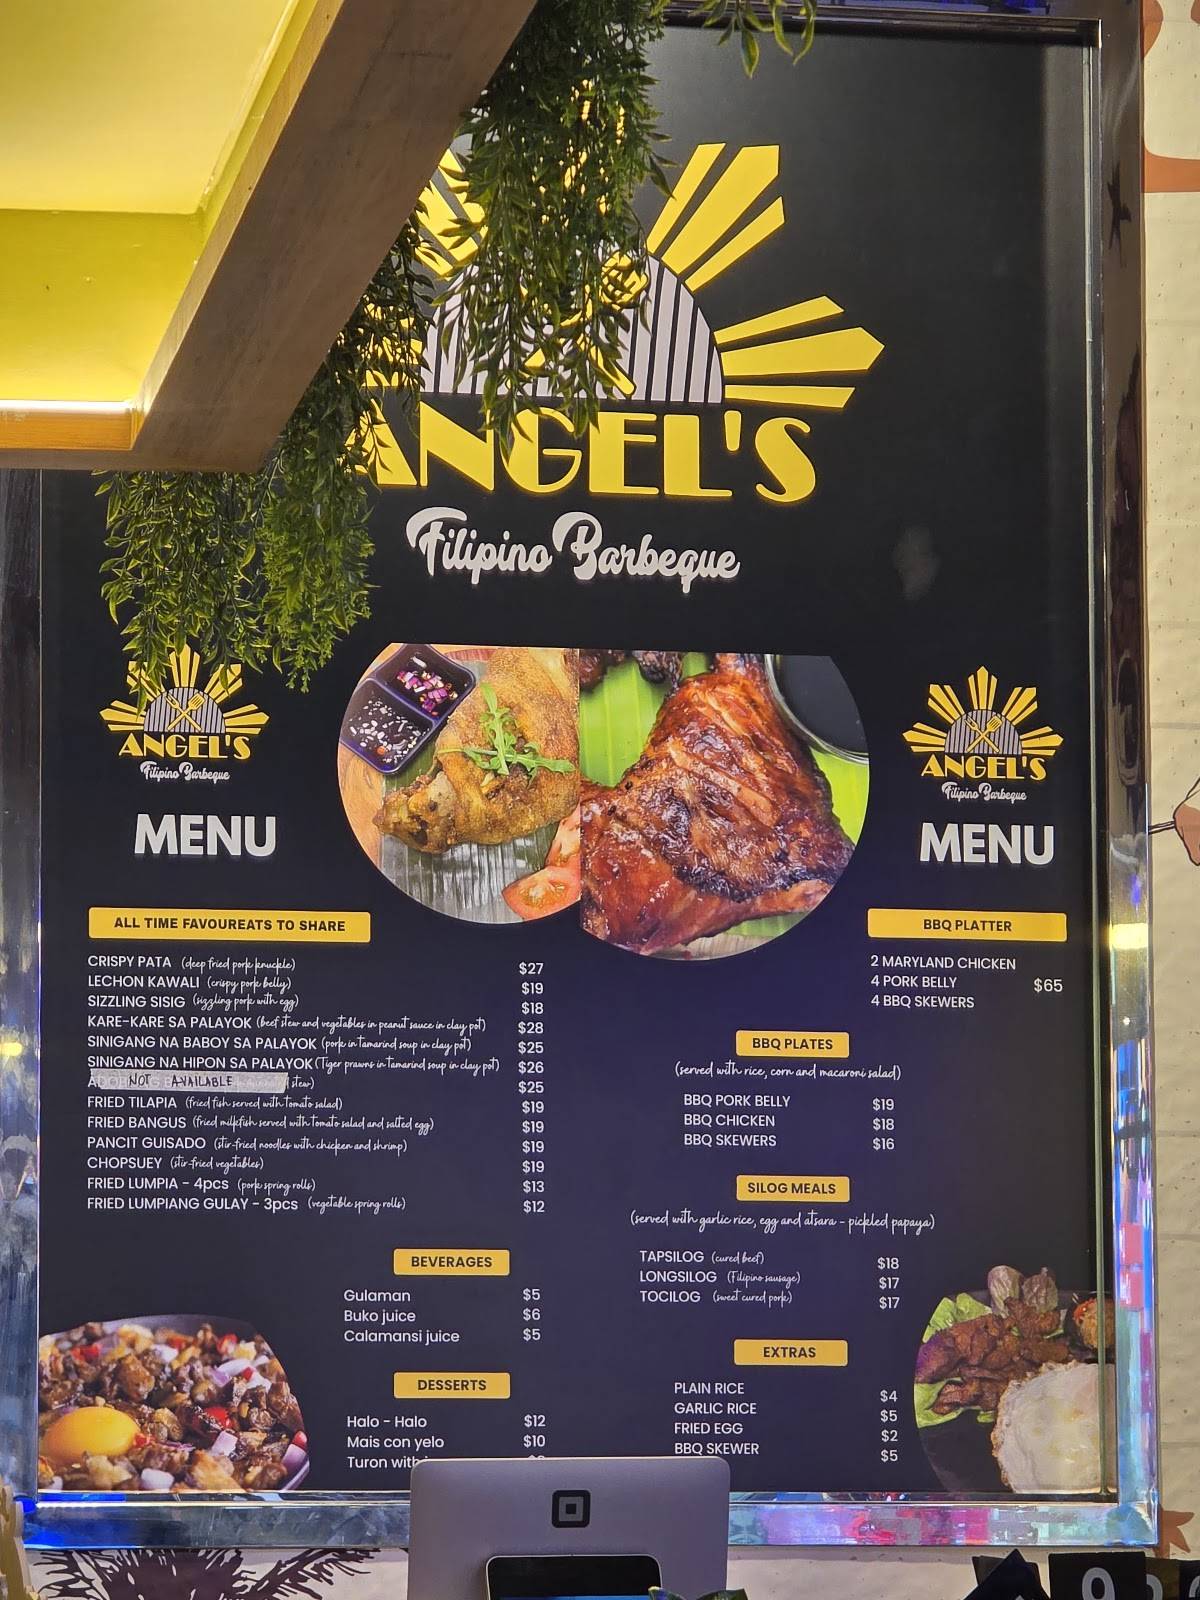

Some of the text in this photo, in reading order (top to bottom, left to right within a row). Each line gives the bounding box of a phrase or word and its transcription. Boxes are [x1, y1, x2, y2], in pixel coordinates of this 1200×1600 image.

[406, 507, 740, 593] Filipino Barbeque
[119, 733, 250, 759] ANGEL'S
[140, 761, 230, 784] Filipino Barbeque
[921, 755, 1047, 781] ANGEL'S
[942, 782, 1027, 804] Filipino Barbeque
[135, 814, 275, 856] MENU
[920, 823, 1053, 865] MENU
[114, 917, 345, 931] ALL TIME FAVOUREATS TO SHARE
[924, 919, 1011, 931] BBQ PLATTER
[88, 956, 296, 975] CRISPY PATA (deep fried pork knuckle)
[519, 962, 543, 975] $27
[871, 955, 1015, 969] 2 MARYLAND CHICKEN
[89, 975, 292, 994] LECHON KAWALI (crispy pork belly)
[871, 975, 956, 988] 4 PORK BELLY
[1034, 978, 1062, 992] $65
[522, 982, 543, 995] $19
[88, 995, 185, 1007] SIZZLING SISIG
[871, 995, 974, 1008] 4 BBQ SKEWERS
[522, 1002, 543, 1014] $18
[88, 1016, 251, 1028] KARE-KARE SA PALAYOK
[519, 1022, 543, 1034] $28
[88, 1036, 316, 1049] SINIGANG NA BABOY SA PALAYOK
[519, 1041, 543, 1054] $25
[753, 1038, 832, 1050] BBQ PLATES
[88, 1056, 312, 1069] SINIGANG NA HIPON SA PALAYOK
[519, 1061, 543, 1074] $26
[675, 1060, 901, 1080] (served with rice, corn and macaroni salad)
[128, 1074, 151, 1086] NOT
[171, 1075, 233, 1087] AVAILABLE
[519, 1081, 544, 1094] $25
[88, 1096, 177, 1108] FRIED TILAPIA
[522, 1101, 544, 1113] $19
[684, 1094, 790, 1107] BBQ PORK BELLY
[873, 1098, 894, 1111] $19
[88, 1116, 186, 1128] FRIED BANGUS
[523, 1120, 544, 1133] $19
[685, 1114, 775, 1127] BBQ CHICKEN
[873, 1118, 894, 1130] $18
[88, 1137, 206, 1148] PANCIT GUISADO
[523, 1140, 544, 1153] $19
[685, 1134, 776, 1147] BBQ SKEWERS
[873, 1138, 894, 1150] $16
[88, 1156, 264, 1174] CHOPSUEY (stir-fried vegetables)
[523, 1160, 544, 1173] $19
[88, 1178, 124, 1189] FRIED
[129, 1178, 178, 1189] LUMPIA
[194, 1178, 228, 1193] 4pcs
[523, 1180, 544, 1193] $13
[748, 1183, 835, 1194] SILOG MEALS
[88, 1198, 124, 1209] FRIED
[129, 1198, 199, 1209] LUMPIANG
[204, 1198, 248, 1209] GULAY
[264, 1198, 298, 1213] 3pcs
[524, 1200, 544, 1213] $12
[412, 1256, 492, 1267] BEVERAGES
[640, 1251, 765, 1265] TAPSILOG (cured beef)
[878, 1257, 899, 1269] $18
[640, 1271, 717, 1282] LONGSILOG
[879, 1277, 899, 1289] $17
[344, 1290, 410, 1301] Gulaman
[523, 1288, 540, 1301] $5
[640, 1291, 700, 1302] TOCILOG
[879, 1297, 899, 1309] $17
[345, 1310, 415, 1325] Buko juice
[523, 1308, 540, 1321] $6
[344, 1330, 459, 1345] Calamansi juice
[523, 1328, 540, 1341] $5
[764, 1347, 816, 1358] EXTRAS
[418, 1380, 486, 1390] DESSERTS
[675, 1383, 744, 1394] PLAIN RICE
[880, 1390, 897, 1402] $4
[675, 1403, 756, 1414] GARLIC RICE
[348, 1416, 379, 1427] Halo
[395, 1416, 427, 1427] Halo
[525, 1415, 545, 1427] $12
[881, 1410, 897, 1422] $5
[675, 1423, 743, 1434] FRIED EGG
[524, 1435, 545, 1448] $10
[882, 1430, 897, 1442] $2
[348, 1436, 444, 1451] Mais con yelo
[675, 1443, 759, 1455] BBQ SKEWER
[347, 1457, 387, 1468] Turon
[881, 1450, 897, 1462] $5
